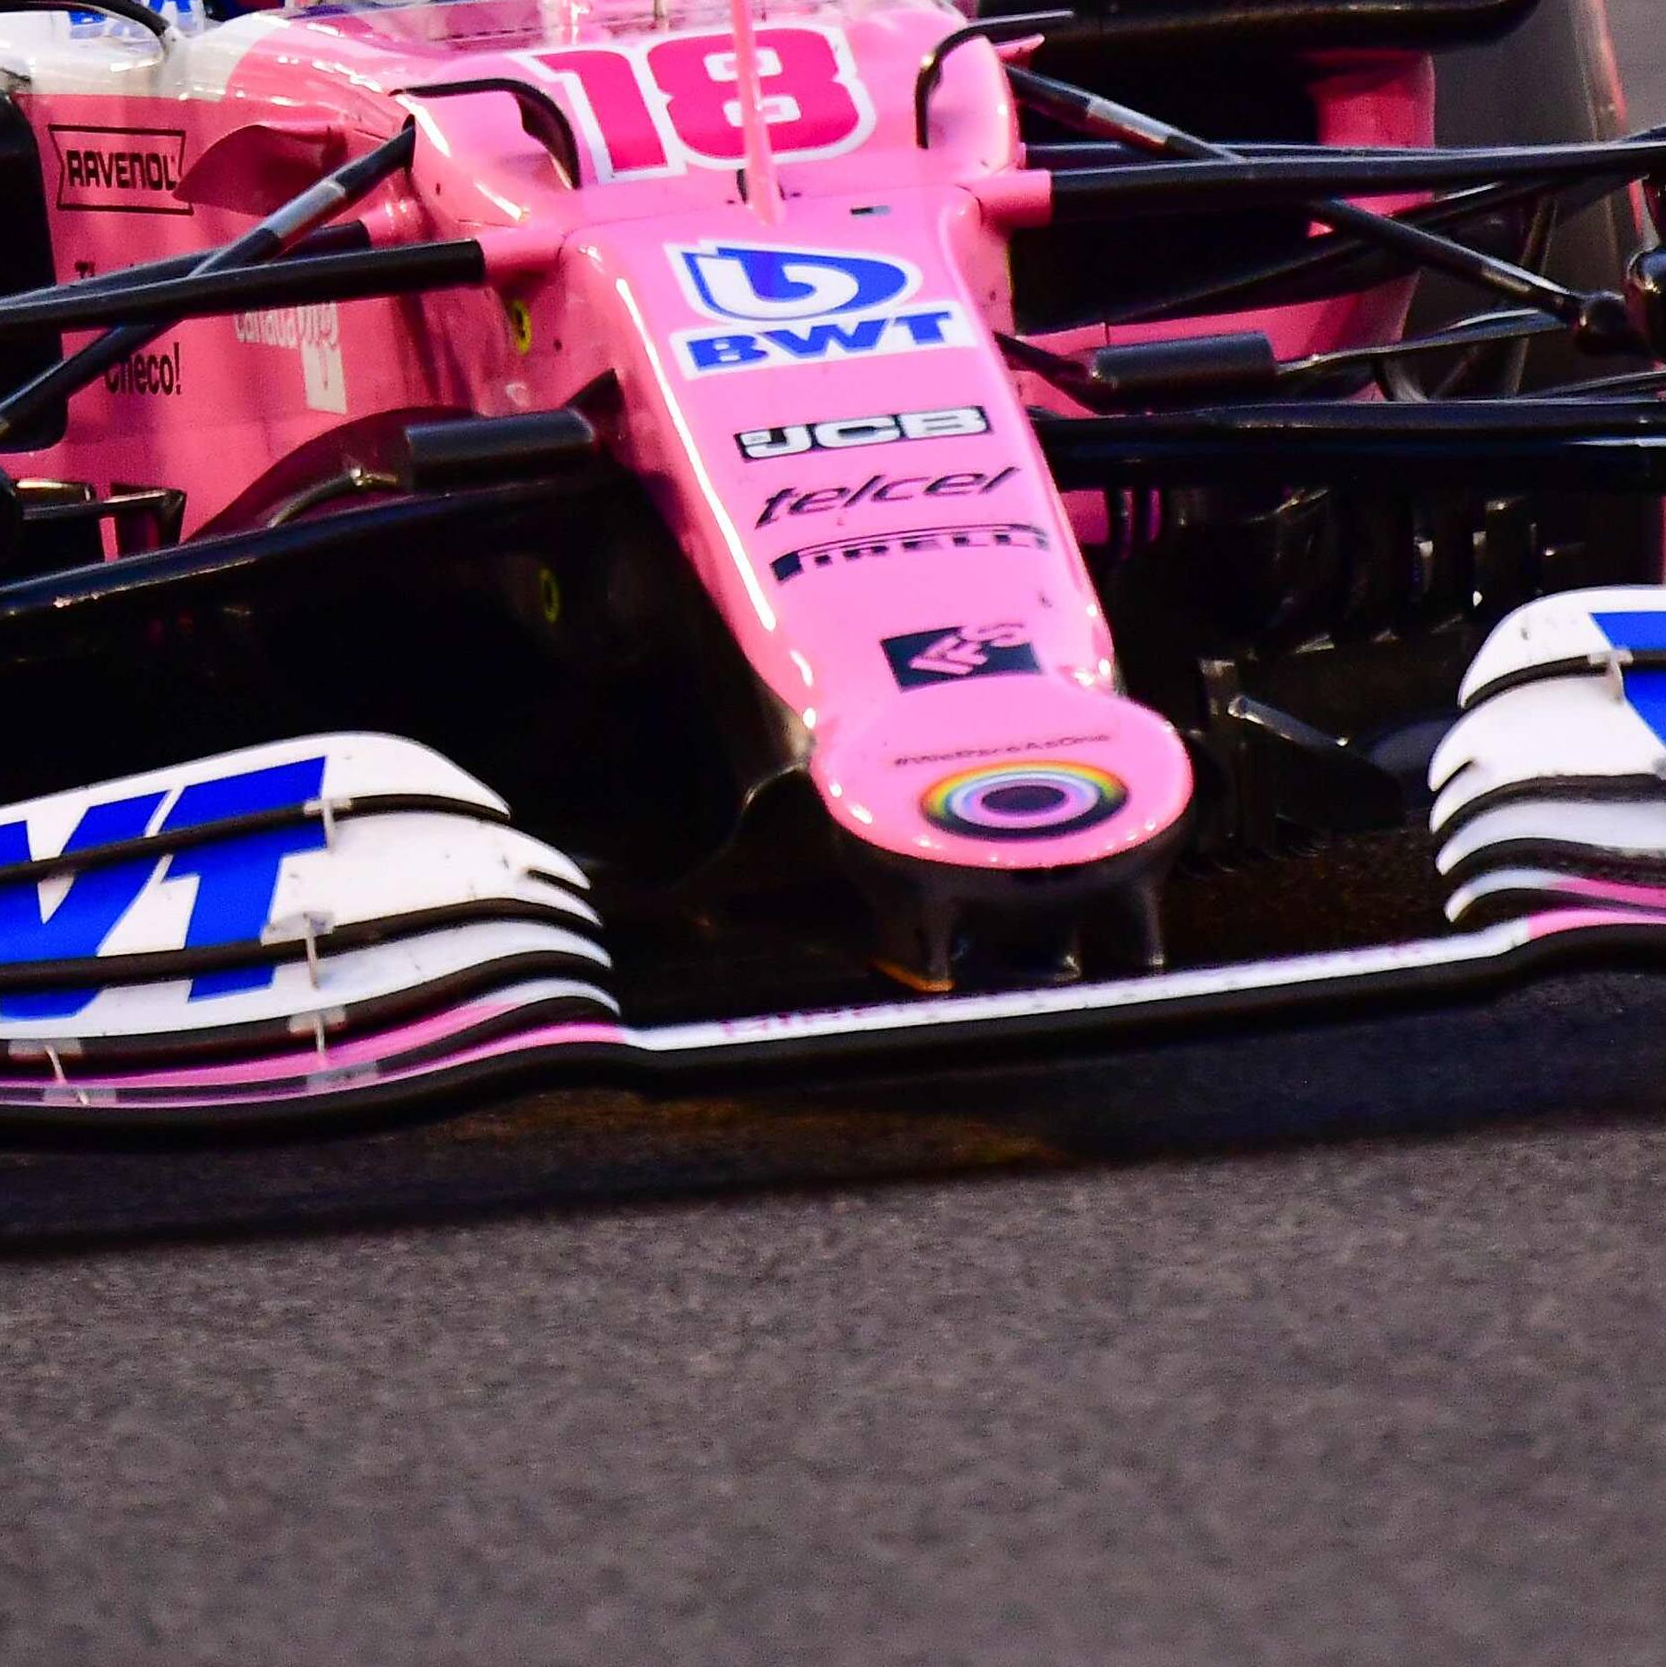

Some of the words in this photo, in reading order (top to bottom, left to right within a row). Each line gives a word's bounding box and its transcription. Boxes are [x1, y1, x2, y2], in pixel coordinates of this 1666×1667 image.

[521, 24, 874, 180] 18
[66, 149, 177, 191] RAVENOL
[685, 310, 952, 371] BWT
[738, 406, 991, 461] JCB
[754, 466, 1021, 530] telcel
